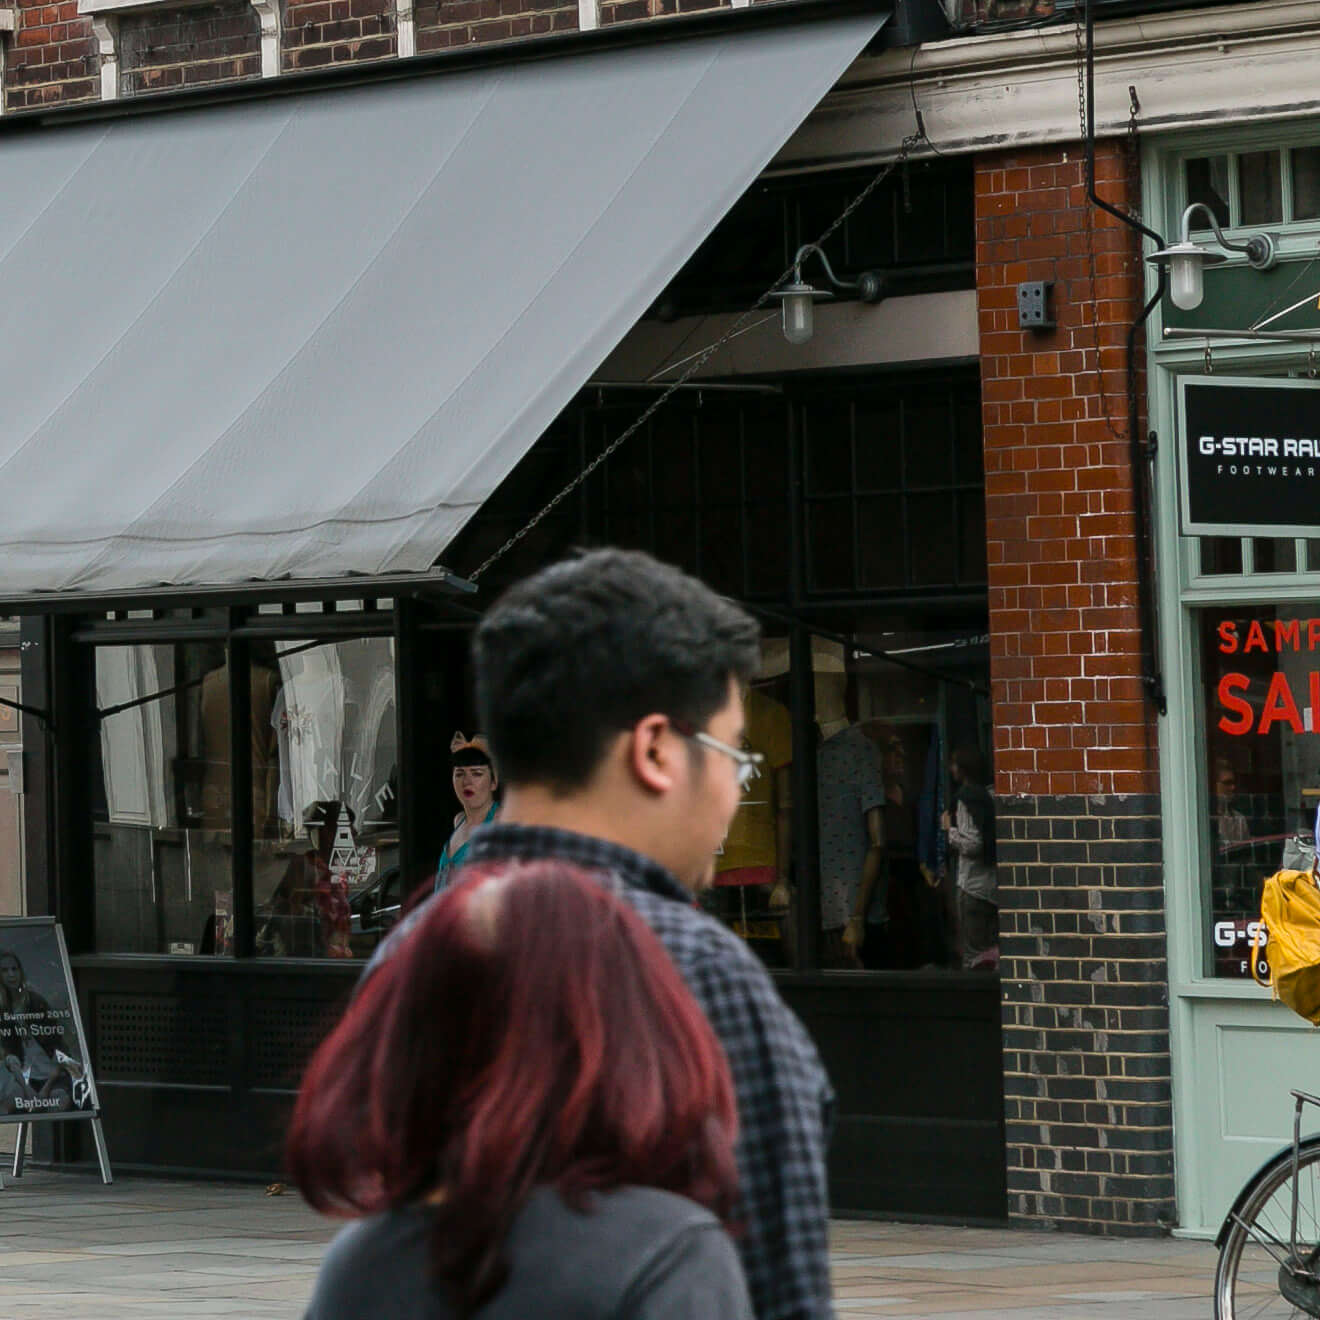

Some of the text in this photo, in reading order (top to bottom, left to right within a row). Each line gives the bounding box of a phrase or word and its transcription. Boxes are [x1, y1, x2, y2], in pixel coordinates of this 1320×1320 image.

[1199, 436, 1279, 457] G-STAR
[1217, 465, 1315, 477] FOOTWEAR
[3, 1011, 44, 1021] Summer
[30, 1024, 65, 1036] Store
[15, 1096, 61, 1109] Barbour
